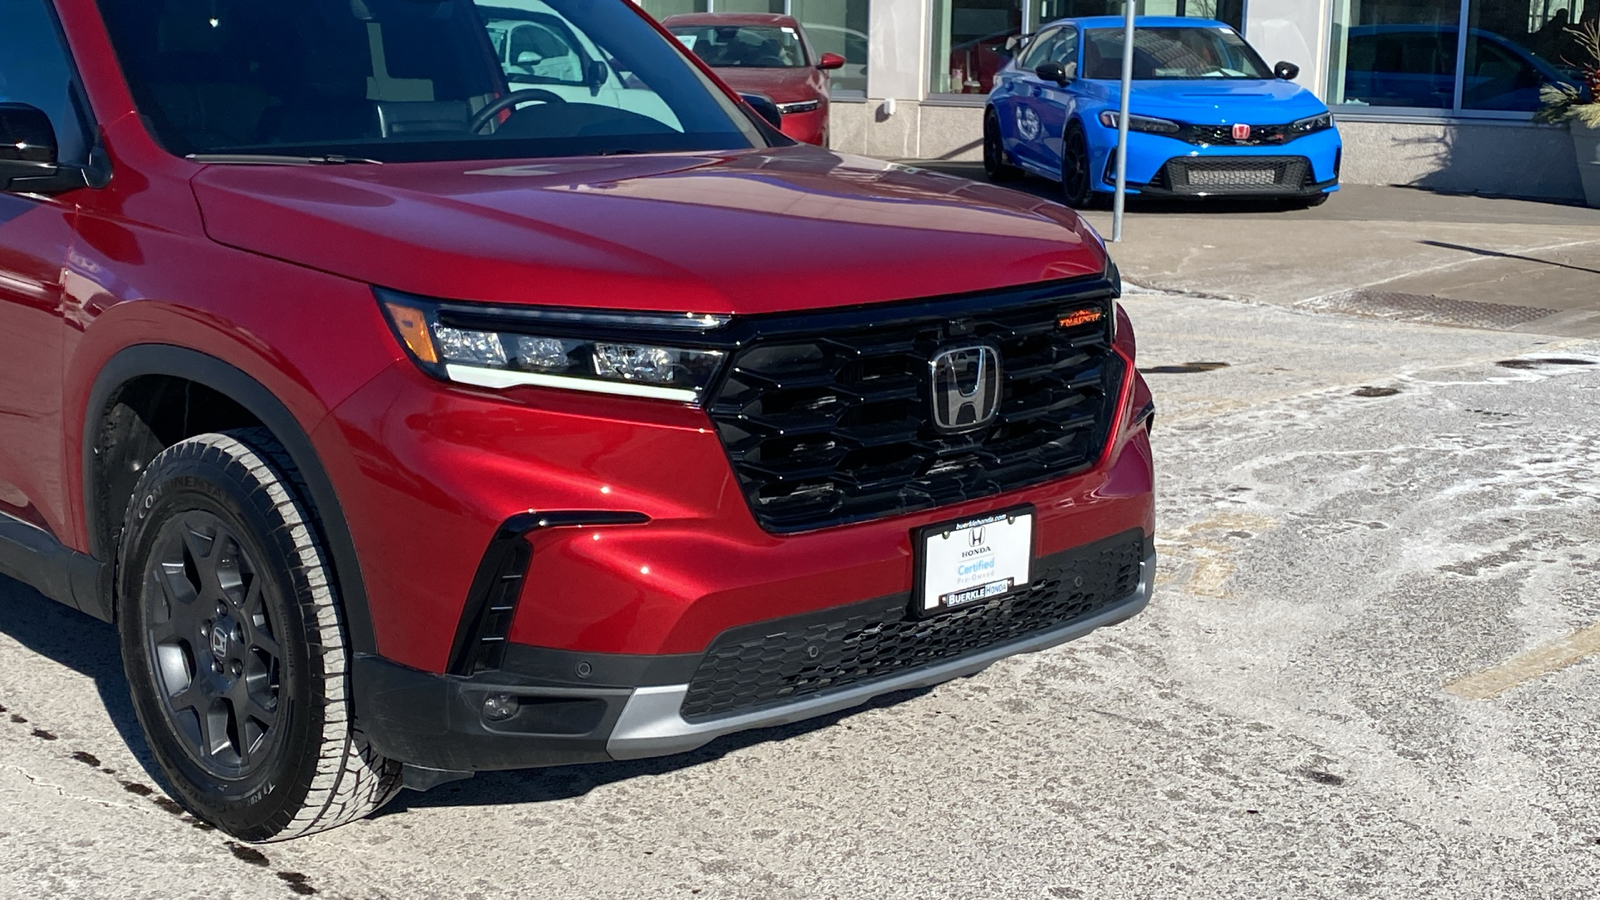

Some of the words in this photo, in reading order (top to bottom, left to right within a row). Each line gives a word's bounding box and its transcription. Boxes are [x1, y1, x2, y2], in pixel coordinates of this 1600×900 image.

[956, 514, 1007, 530] buerklehonda.com
[961, 546, 992, 558] HONDA
[957, 557, 995, 576] Certified
[957, 570, 995, 584] Pre-Owned
